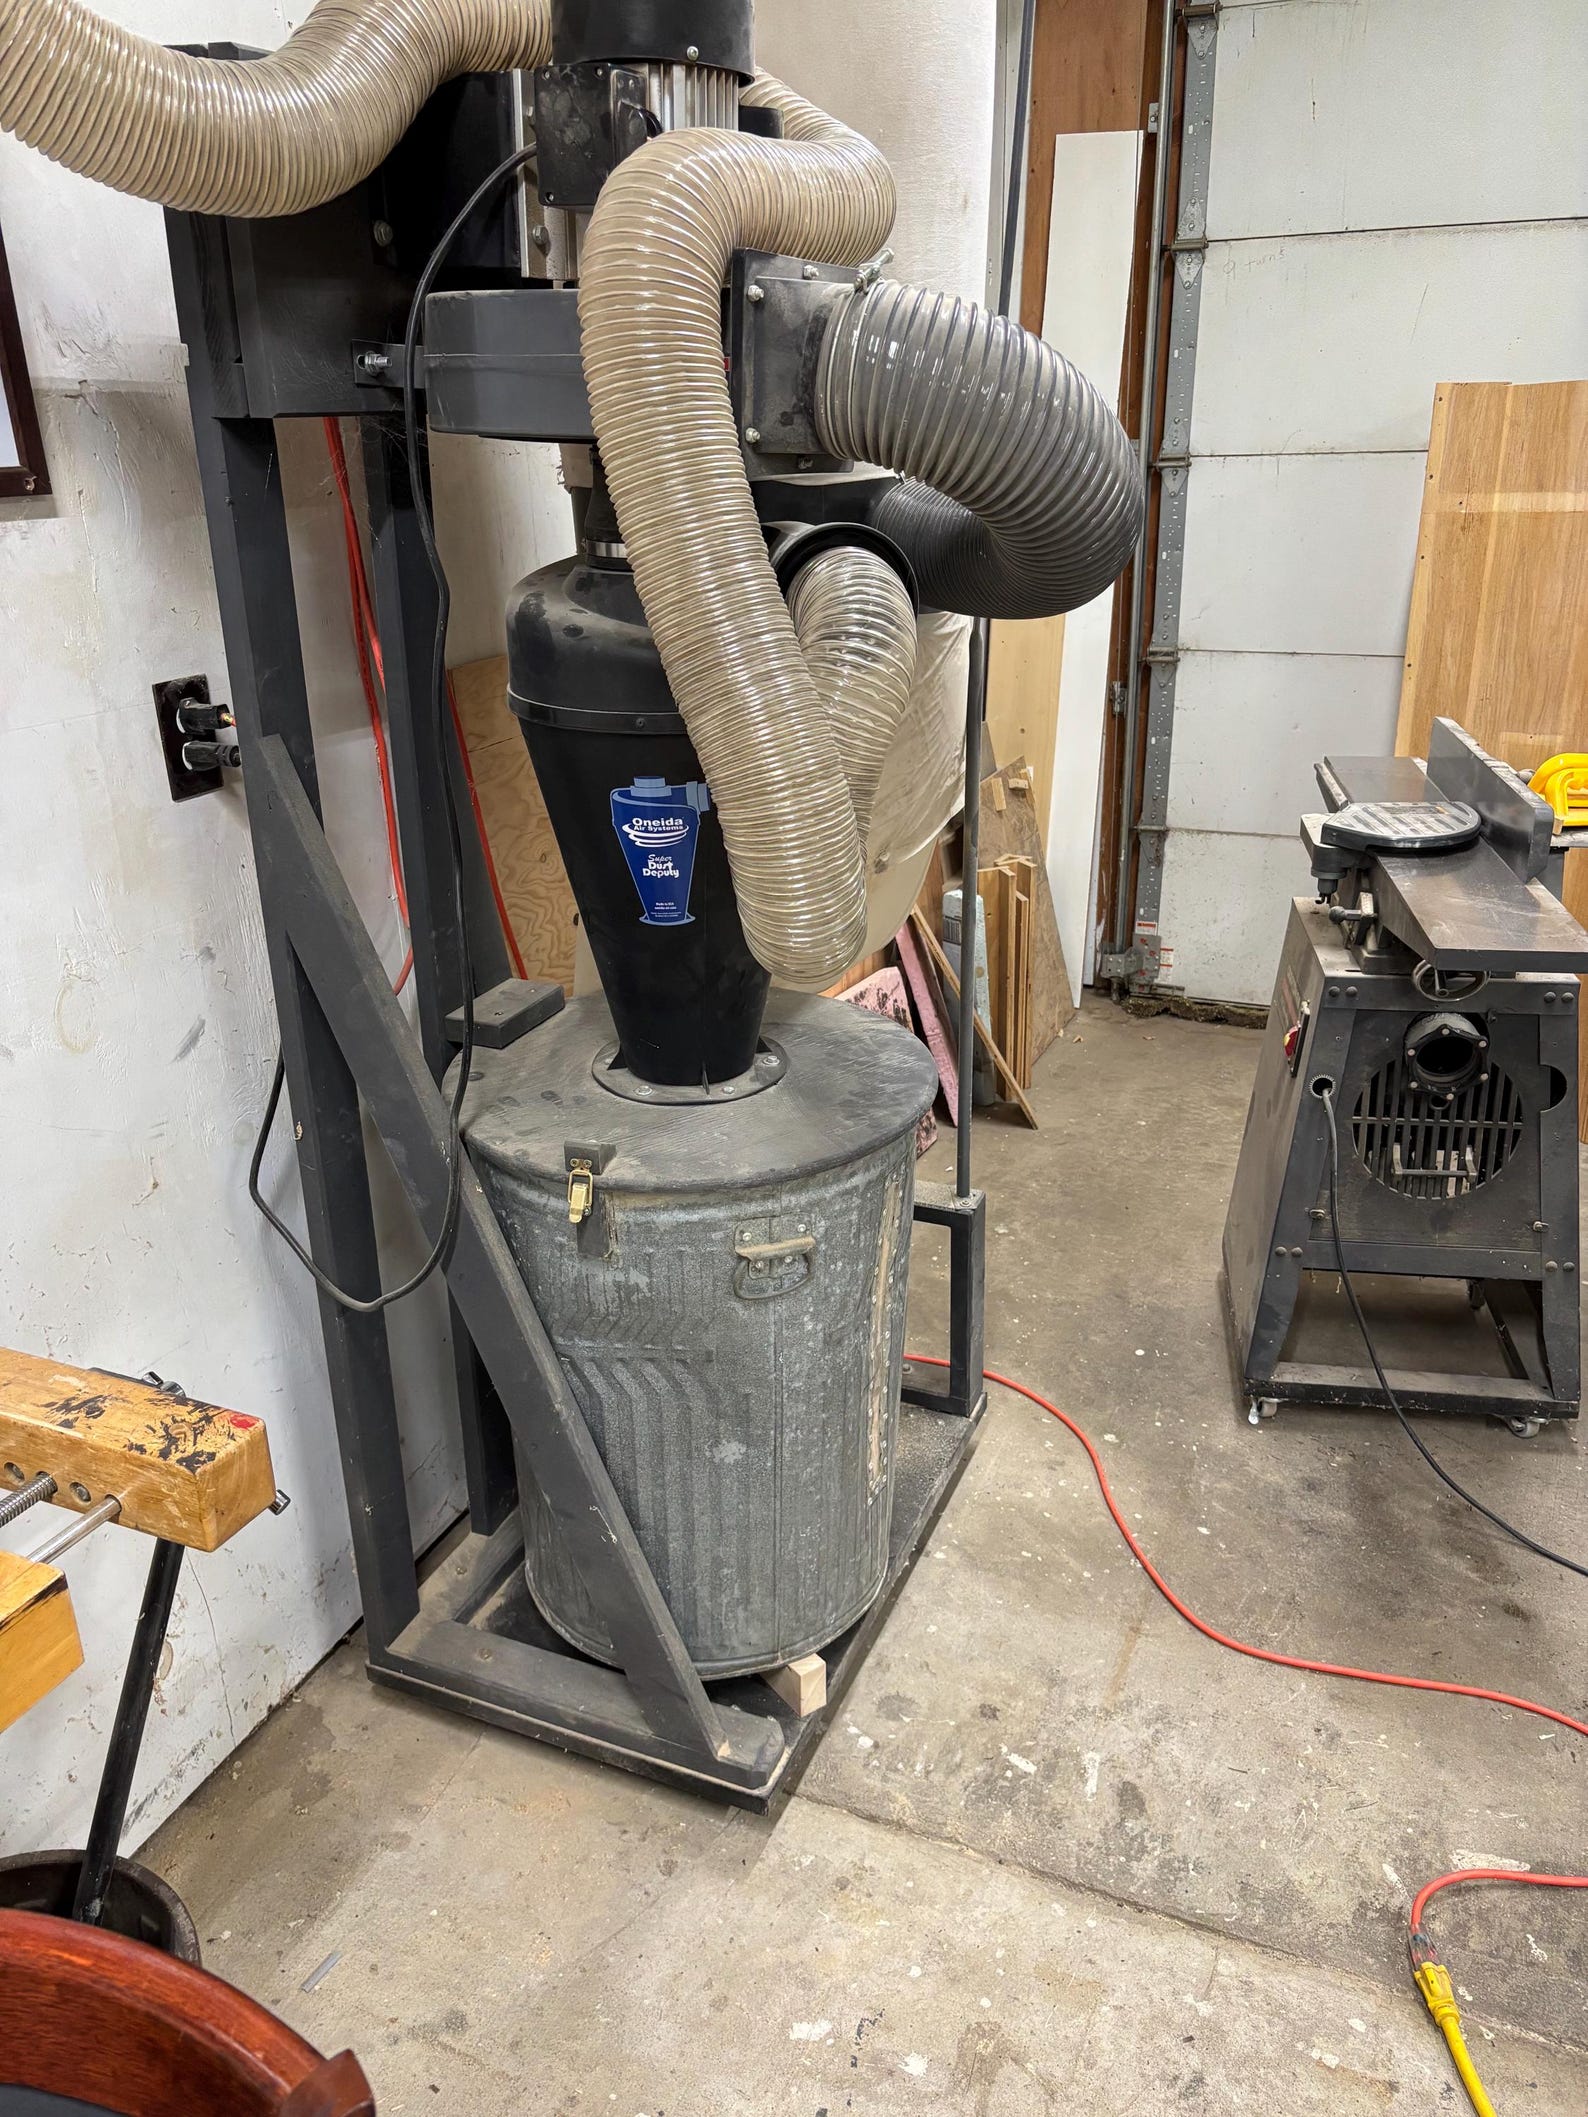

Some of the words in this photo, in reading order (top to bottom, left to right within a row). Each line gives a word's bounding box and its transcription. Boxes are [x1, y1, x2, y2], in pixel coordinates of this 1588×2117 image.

[632, 817, 683, 826] Oneida
[648, 854, 672, 863] Super
[648, 860, 673, 870] Dust
[642, 868, 679, 878] Deputy
